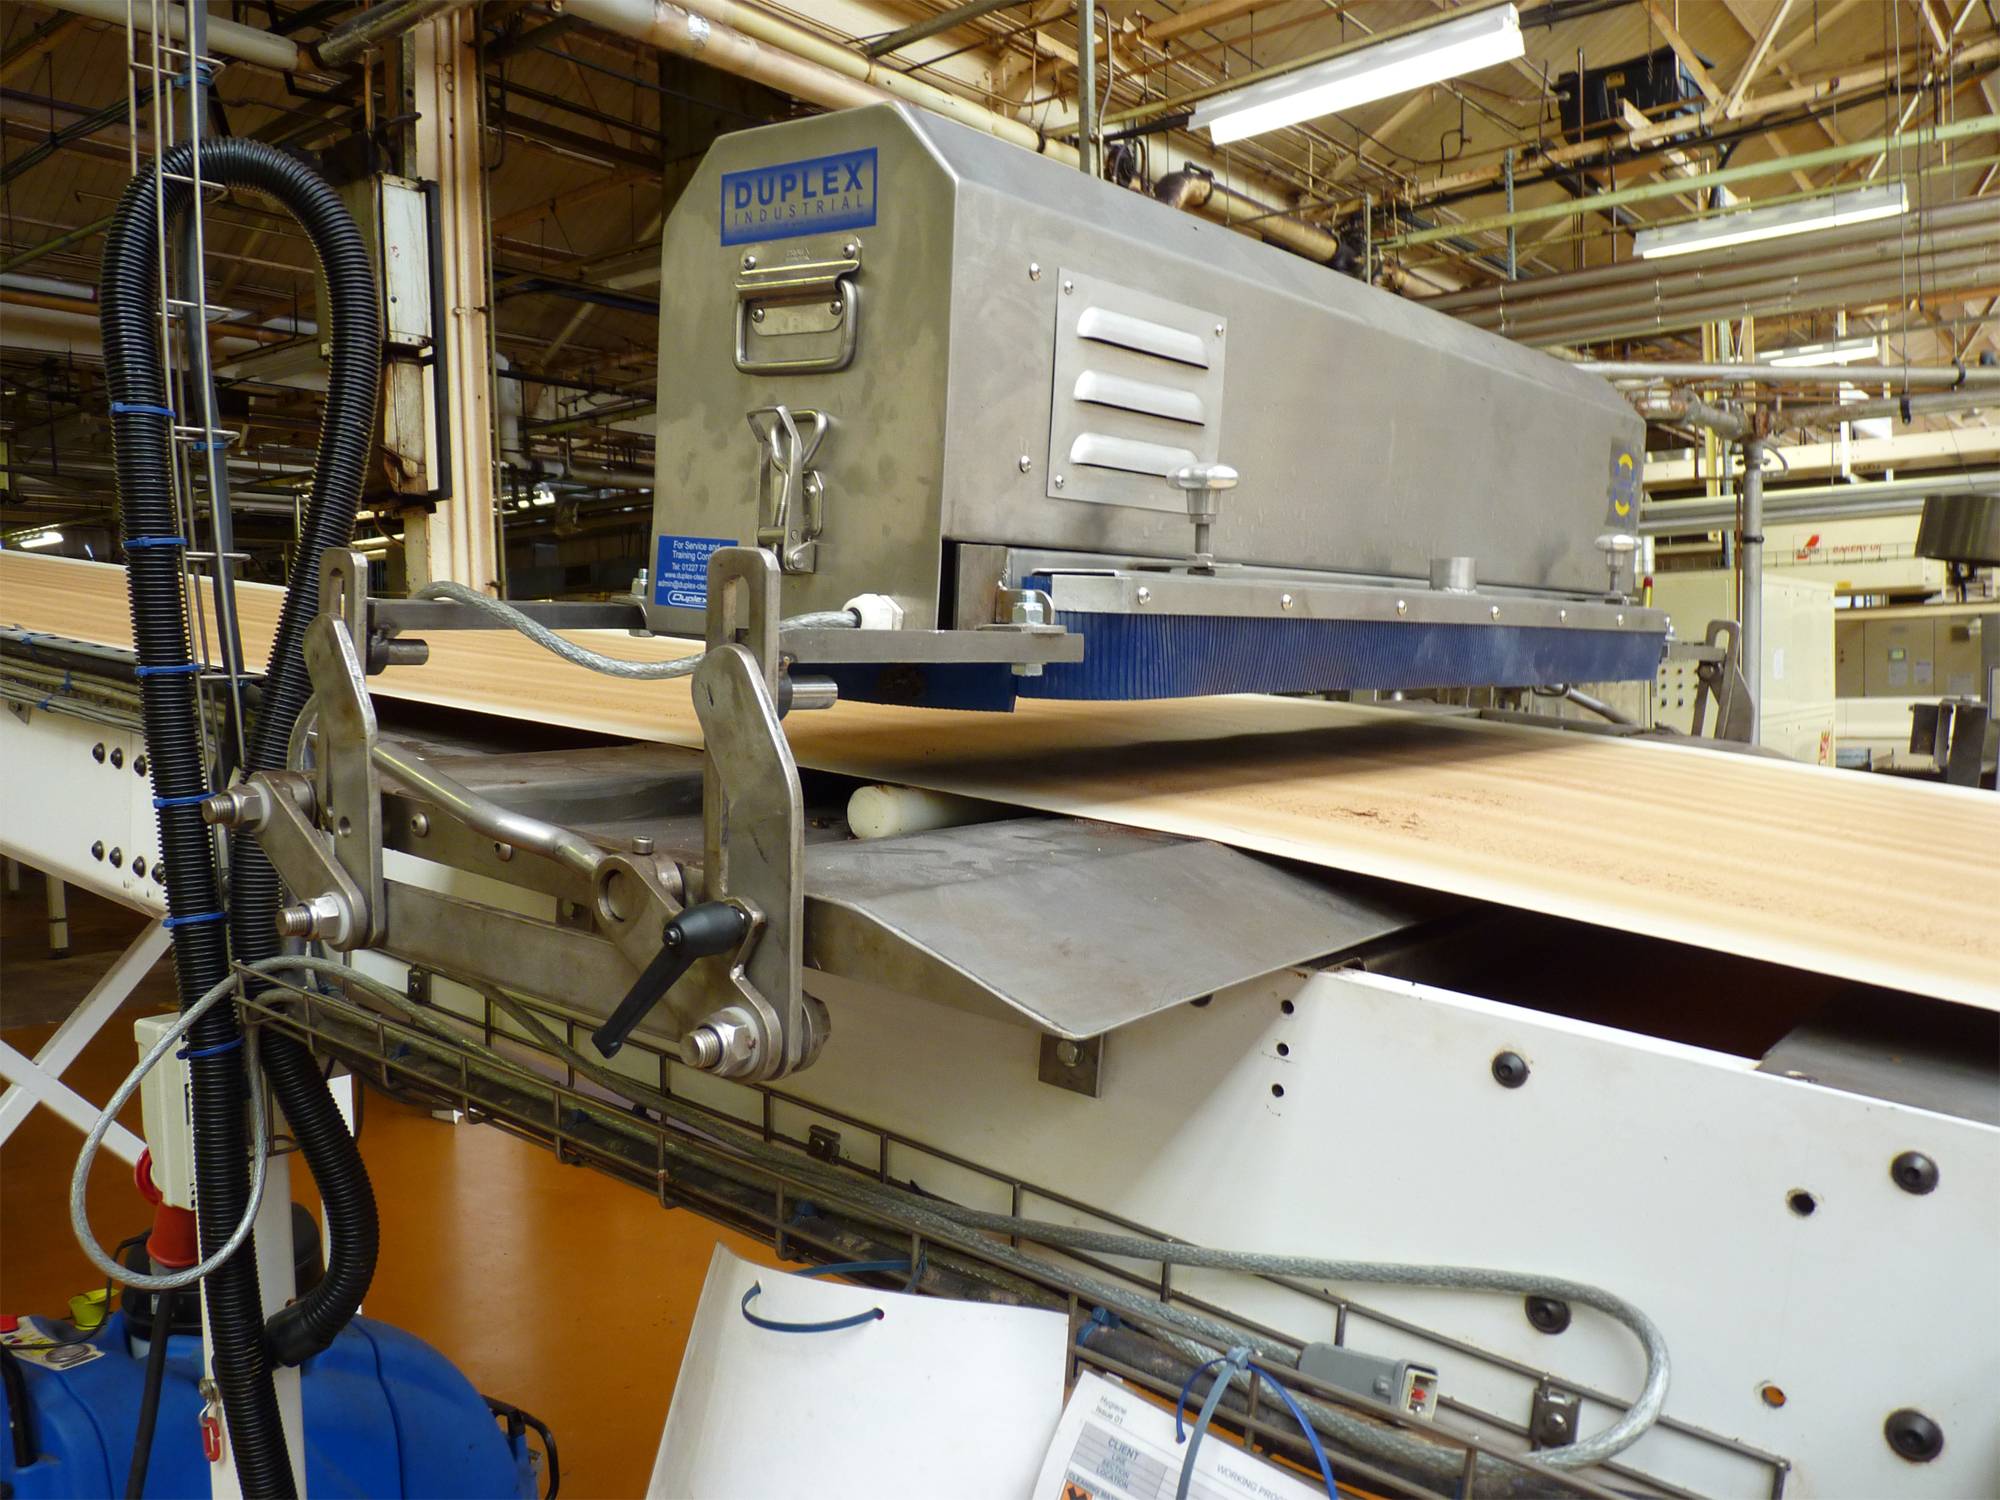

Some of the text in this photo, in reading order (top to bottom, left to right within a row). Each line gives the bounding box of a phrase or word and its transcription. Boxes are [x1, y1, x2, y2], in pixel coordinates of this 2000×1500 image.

[734, 160, 863, 209] DUPLEX
[734, 194, 864, 225] INDUSTRIAL
[672, 550, 696, 562] Training
[673, 540, 684, 549] For
[685, 541, 707, 551] Service
[681, 563, 699, 572] 01227
[1107, 1437, 1140, 1461] CLIENT
[1216, 1464, 1258, 1492] WORKING
